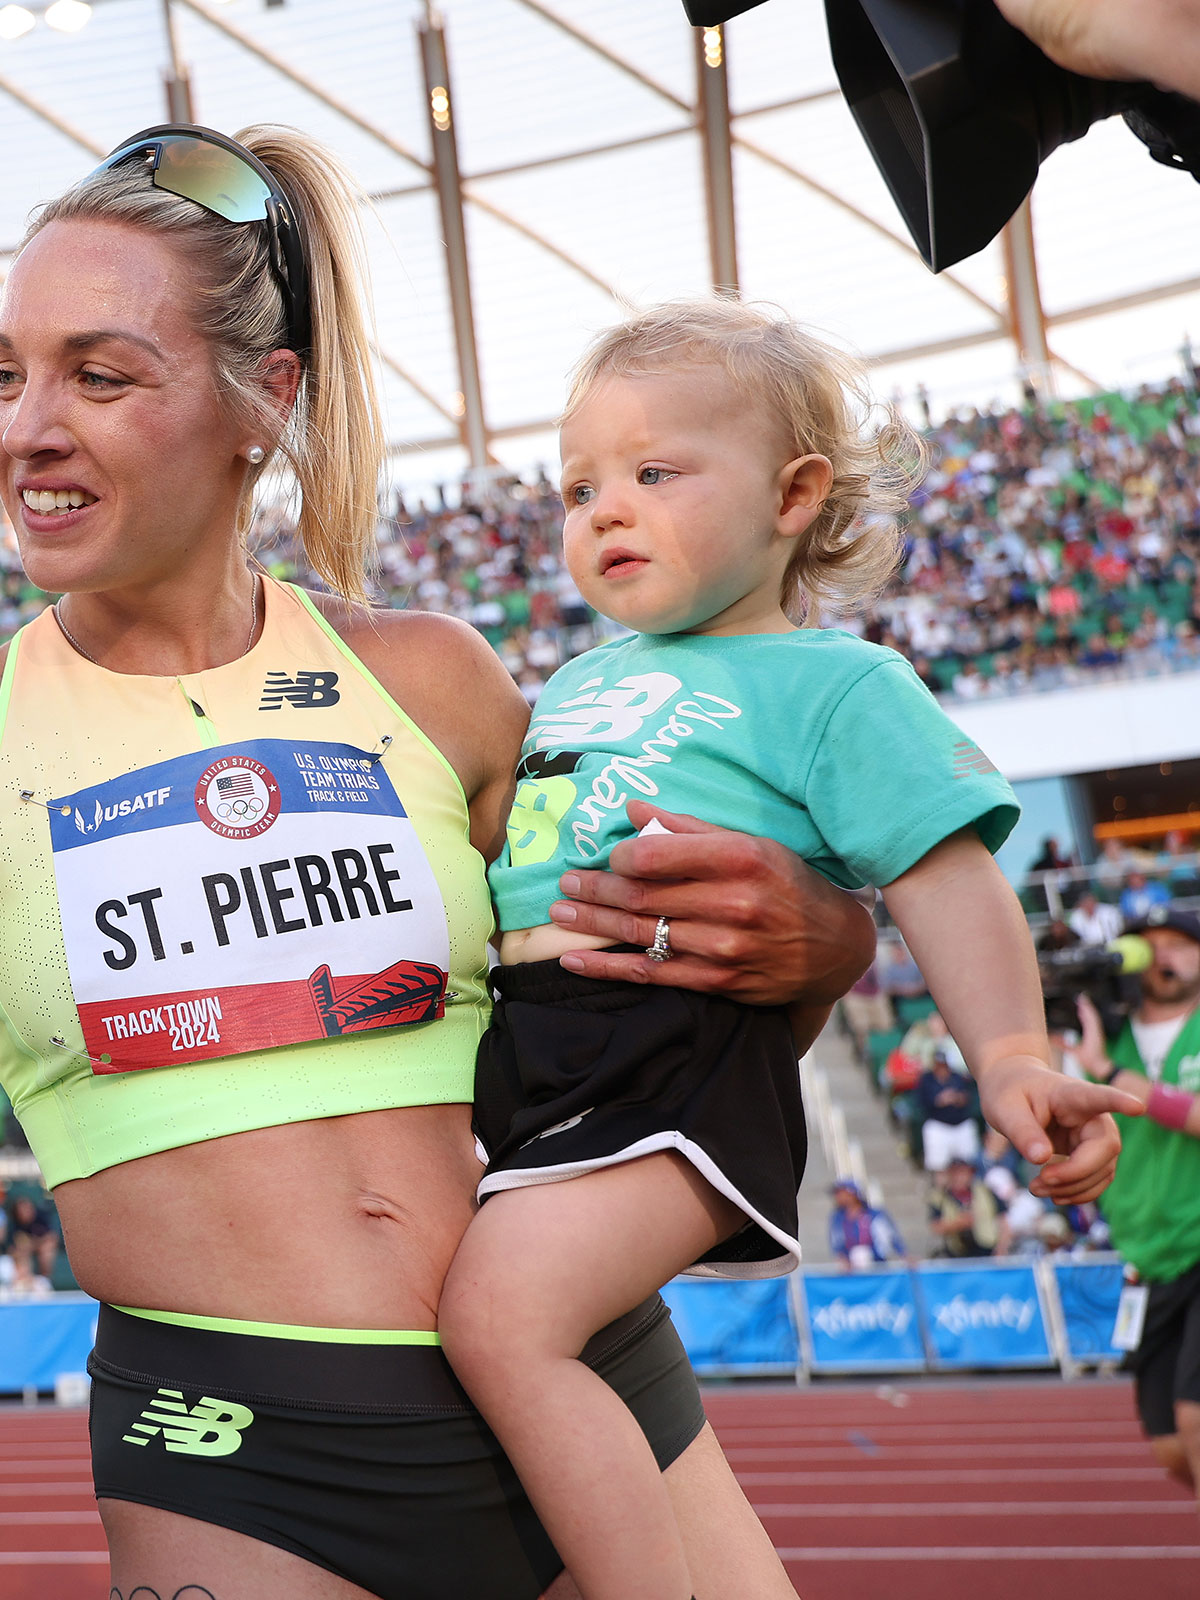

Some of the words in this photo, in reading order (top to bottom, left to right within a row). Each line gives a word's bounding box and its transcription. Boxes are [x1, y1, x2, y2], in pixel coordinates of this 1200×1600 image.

[258, 670, 341, 711] NB
[200, 760, 229, 787] UNITED
[232, 758, 266, 776] STATES
[293, 752, 319, 770] U.S.
[300, 771, 337, 788] TEAM
[337, 772, 380, 790] TRIALS
[306, 790, 335, 803] TRACK
[336, 791, 344, 802] &
[345, 791, 369, 802] FIELD
[104, 786, 172, 822] USATF
[210, 820, 251, 837] OLYMPIC
[255, 812, 276, 833] TEAM
[94, 887, 195, 971] ST.
[201, 843, 413, 948] PIERRE
[101, 996, 223, 1041] TRACKTOWN
[168, 1017, 221, 1051] 2024
[121, 1387, 255, 1457] NB
